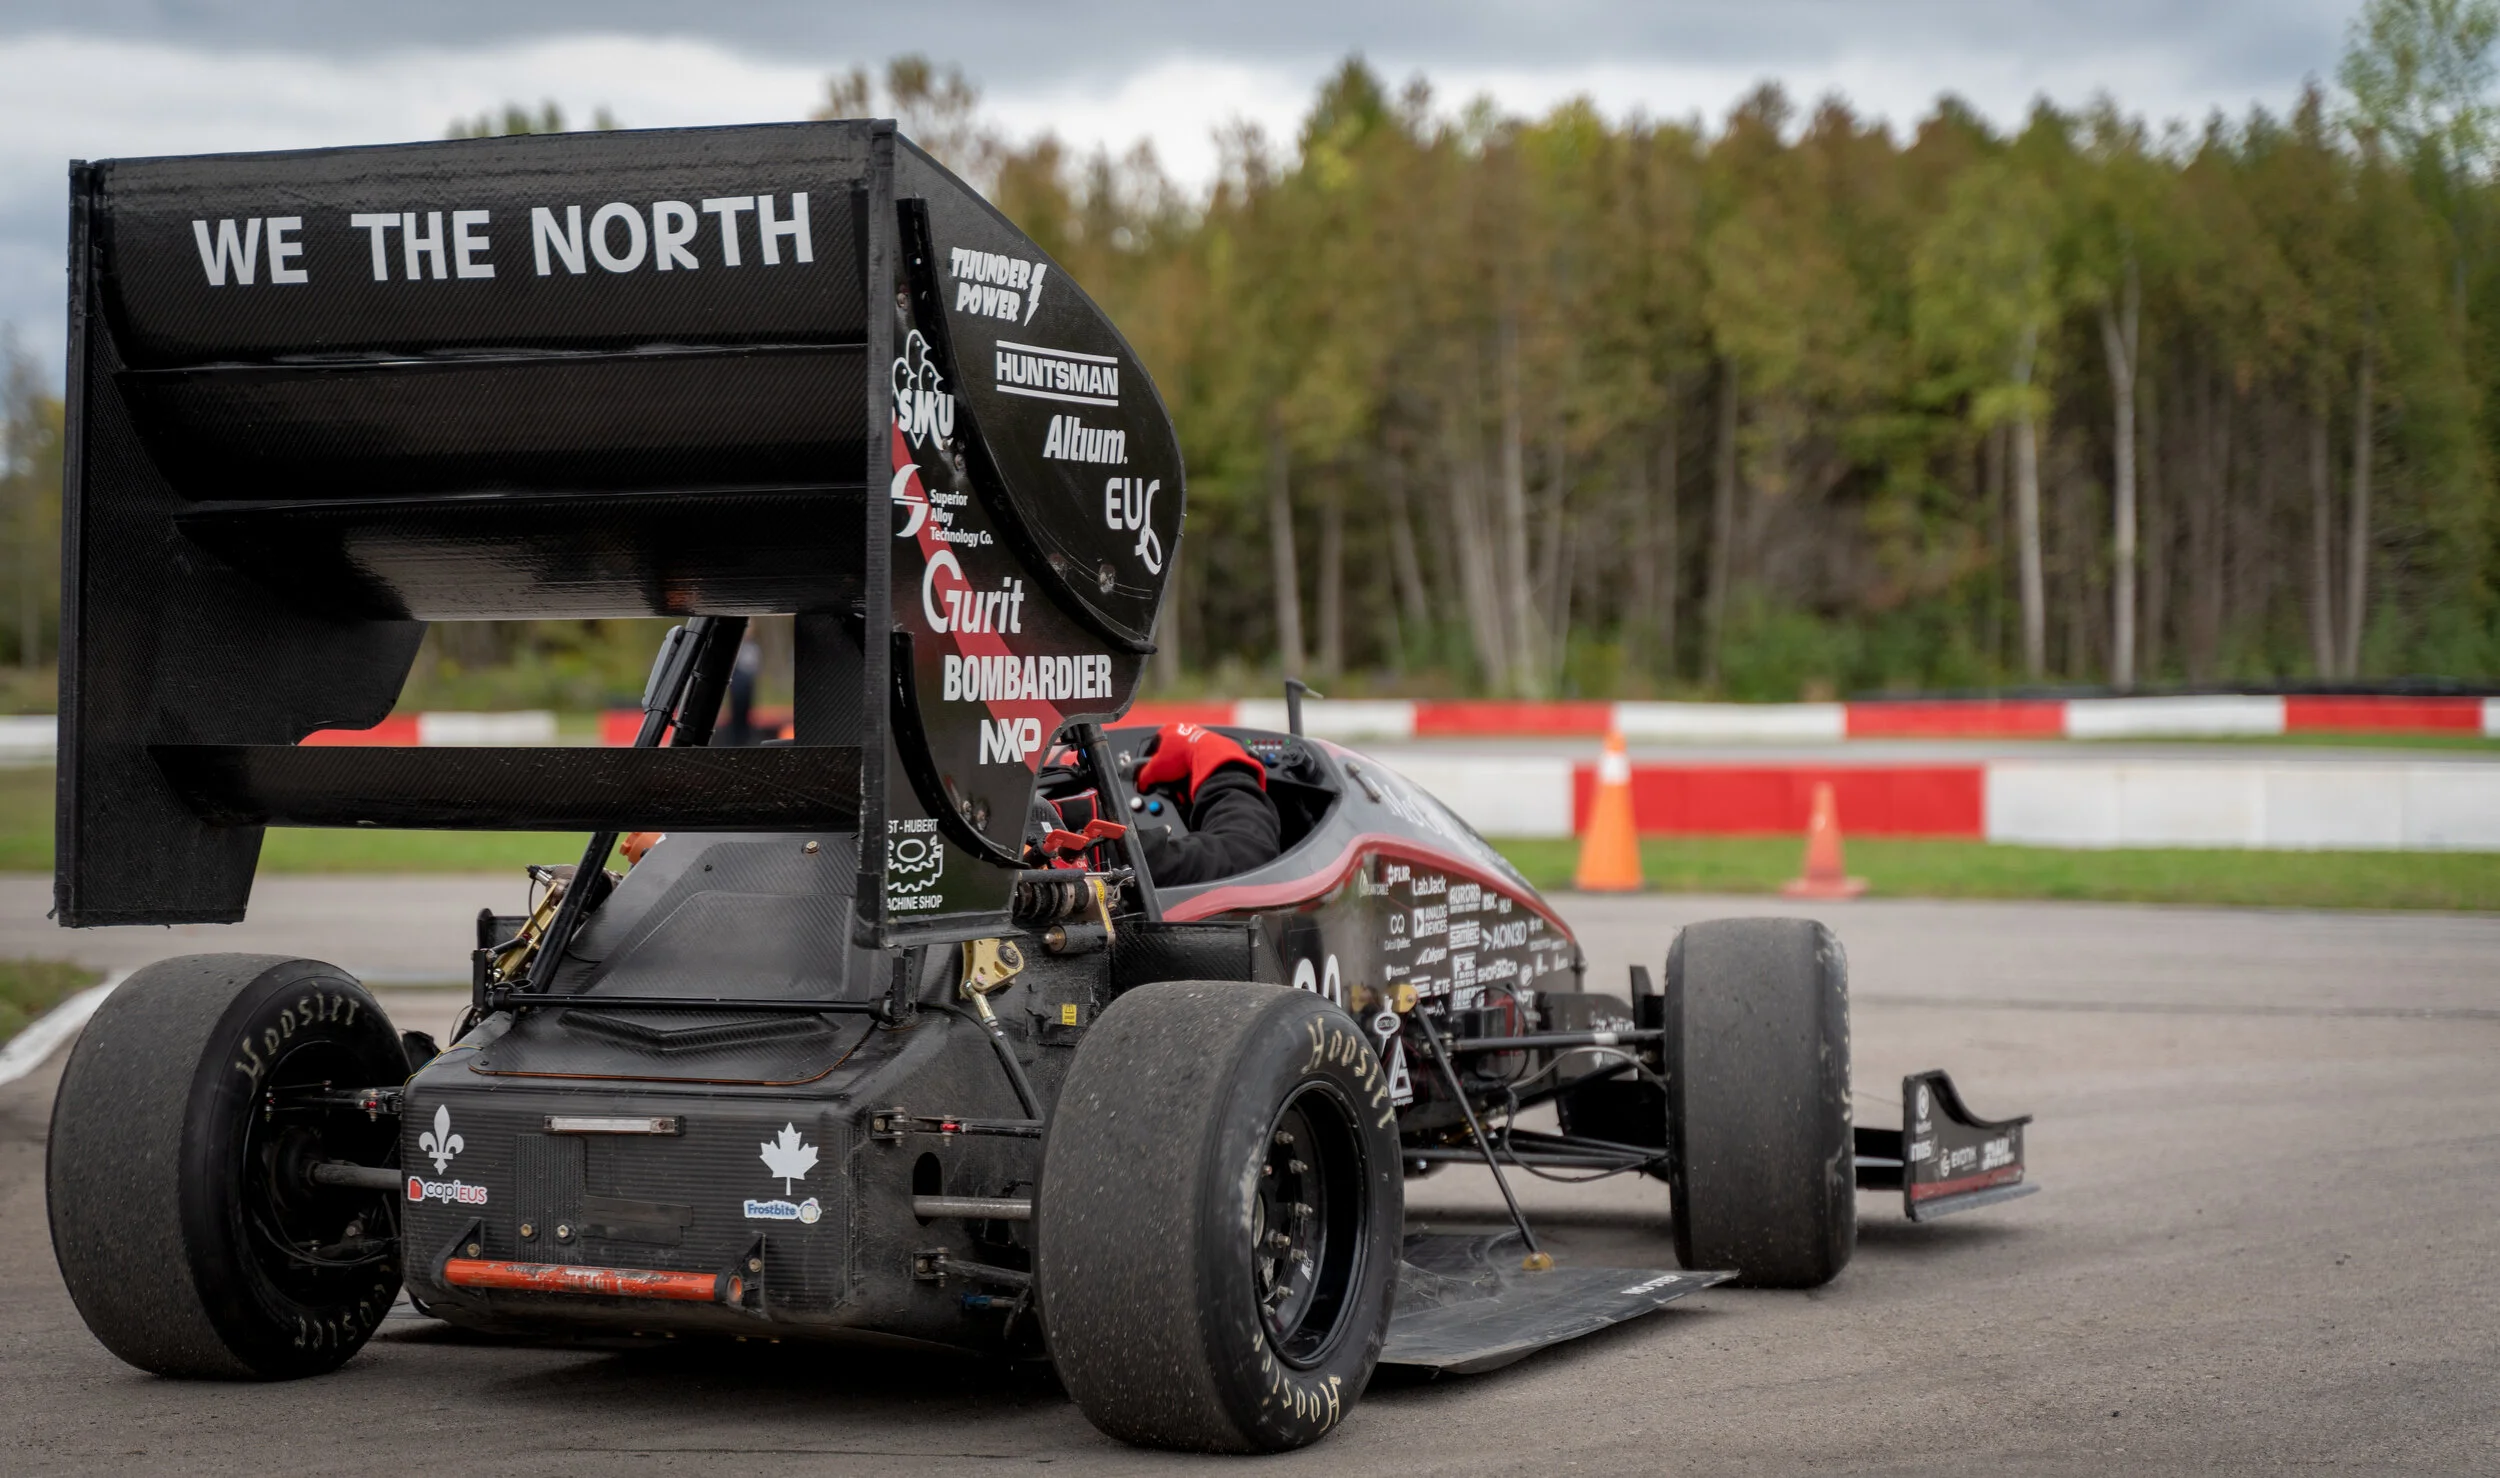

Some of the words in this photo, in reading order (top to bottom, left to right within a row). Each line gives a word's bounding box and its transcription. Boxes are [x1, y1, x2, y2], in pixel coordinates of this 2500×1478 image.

[192, 216, 309, 287] WE
[350, 209, 496, 282] THE
[530, 191, 814, 277] NORTH
[951, 247, 1032, 291] THUNDER
[955, 283, 1021, 322] POWER
[996, 351, 1118, 396] HUNTSMAN
[930, 488, 969, 508] Superior
[930, 507, 954, 528] Alloy
[929, 526, 980, 548] Technology
[979, 529, 994, 545] Co.
[922, 549, 1025, 635] Gurit
[943, 654, 1112, 702] BOMBARDIER
[979, 717, 1042, 765] NXP
[1412, 875, 1447, 896] LabJack
[1448, 883, 1481, 905] AURORA
[887, 896, 918, 911] ACHINE
[918, 894, 943, 909] SHOP
[1425, 904, 1448, 921] ANALOG
[1425, 919, 1448, 937] DEVICES
[1492, 919, 1527, 952] AON3D
[425, 1181, 486, 1202] copiEUS
[747, 1202, 796, 1216] Frostbite
